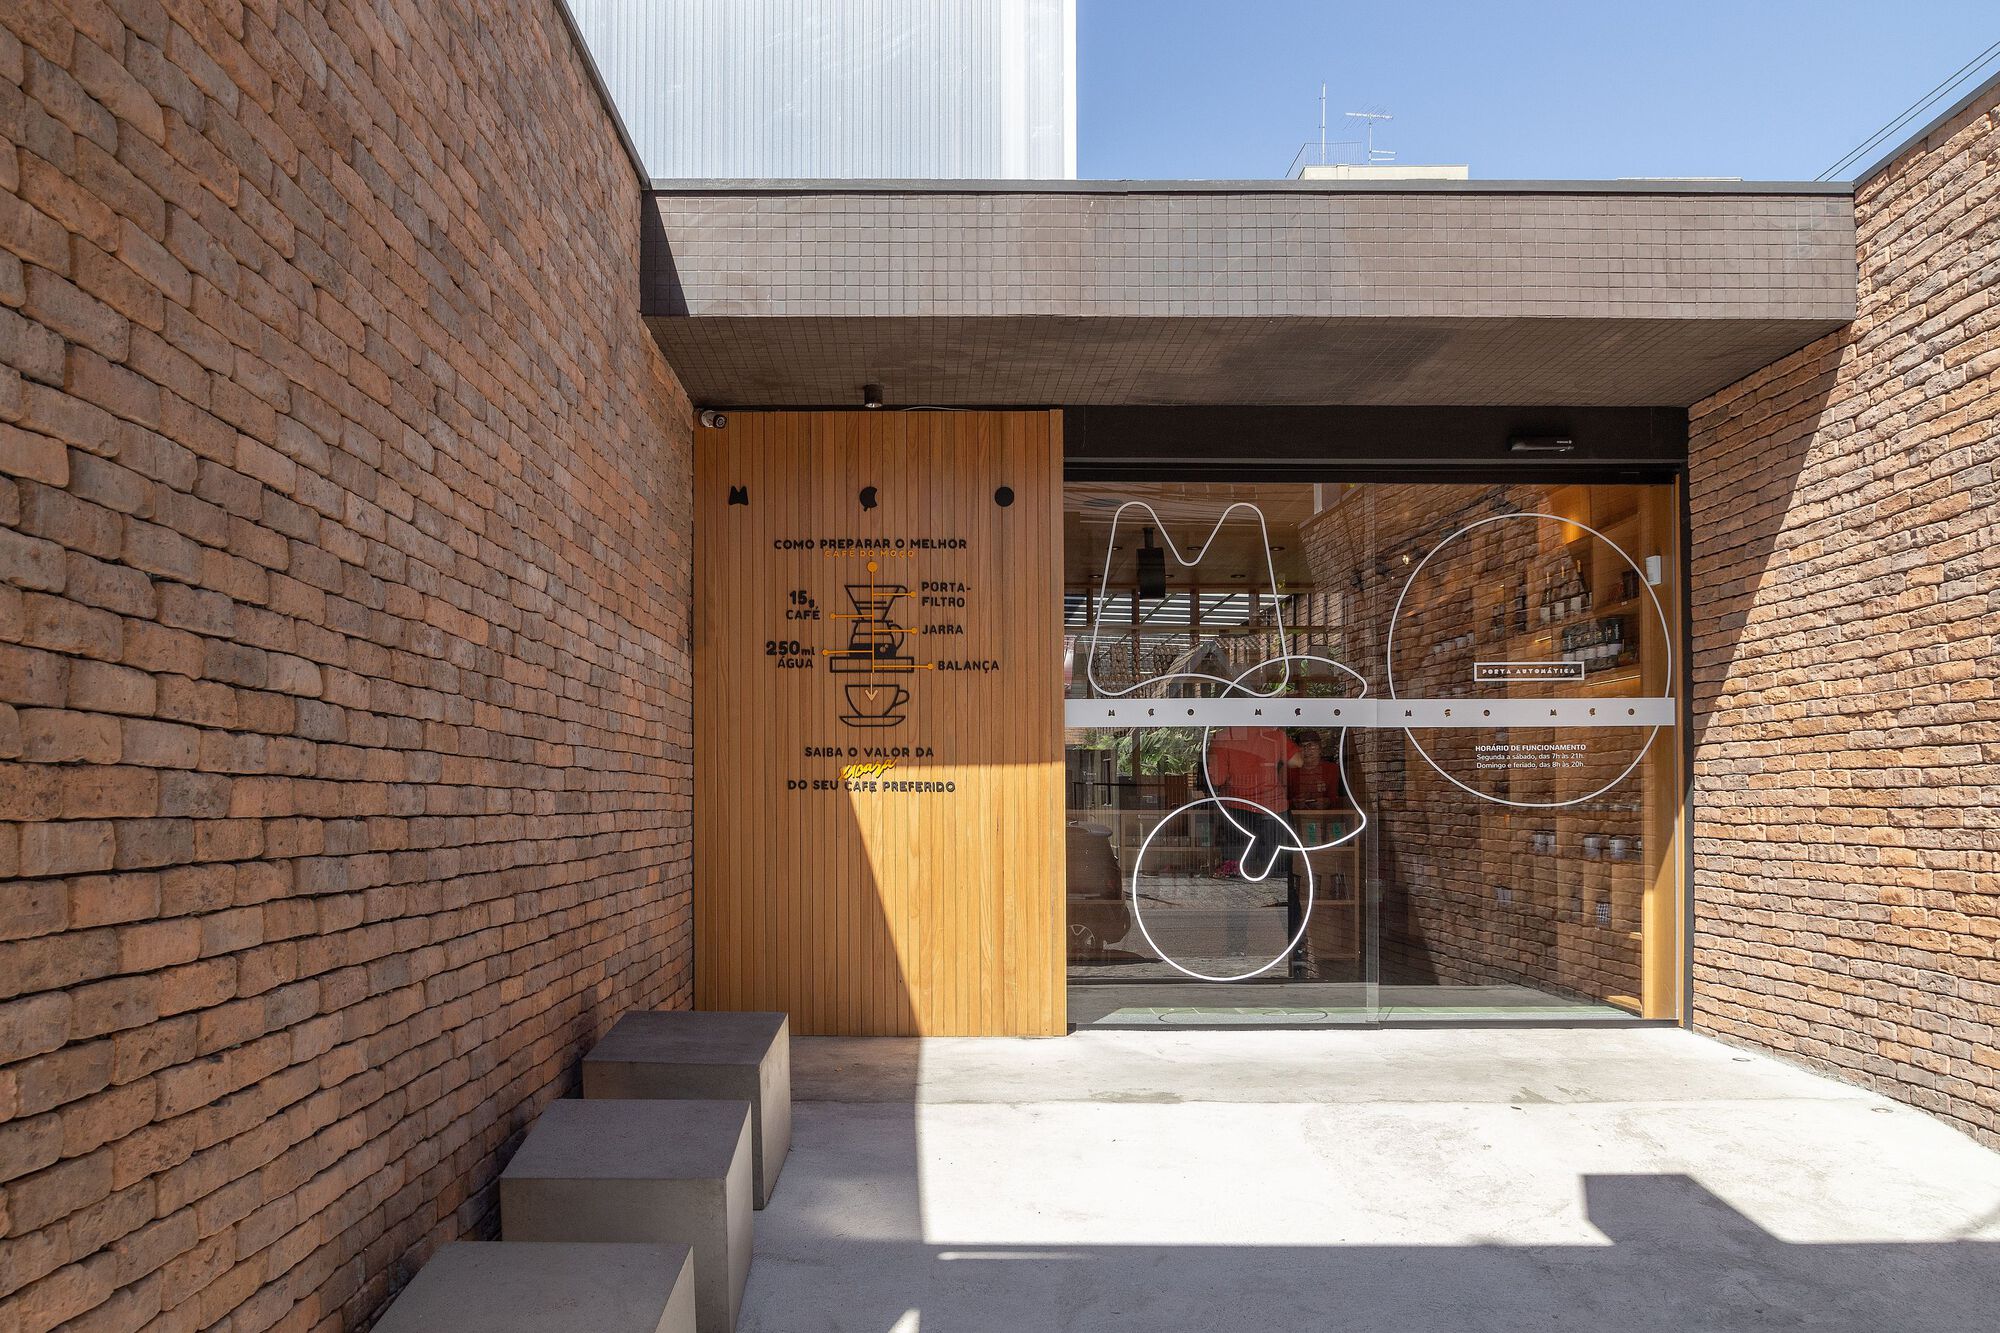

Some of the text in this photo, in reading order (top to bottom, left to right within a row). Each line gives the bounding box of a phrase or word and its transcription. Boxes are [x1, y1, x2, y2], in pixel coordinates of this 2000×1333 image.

[774, 538, 967, 549] COMO PREPARAR O MELHOR
[825, 547, 855, 558] CAFÉ
[880, 549, 914, 559] MOÇO
[921, 581, 971, 593] PORTA-
[789, 590, 815, 609] 15g
[921, 596, 965, 607] FILTRO
[786, 606, 821, 620] CAFÉ
[922, 624, 963, 635] JARRA
[777, 655, 814, 668] ÁGUA
[937, 660, 999, 673] BALANÇA
[1516, 666, 1576, 674] AUTOMÁTICA
[804, 747, 934, 757] SAIBA O VALOR DA
[1475, 743, 1509, 751] HORÁRIO
[1476, 753, 1505, 761] Segunda
[1512, 753, 1537, 761] sábado,
[1476, 762, 1506, 770] Domingo
[787, 780, 808, 790] DO
[813, 780, 839, 790] SEU
[883, 781, 956, 792] PREFERIDO
